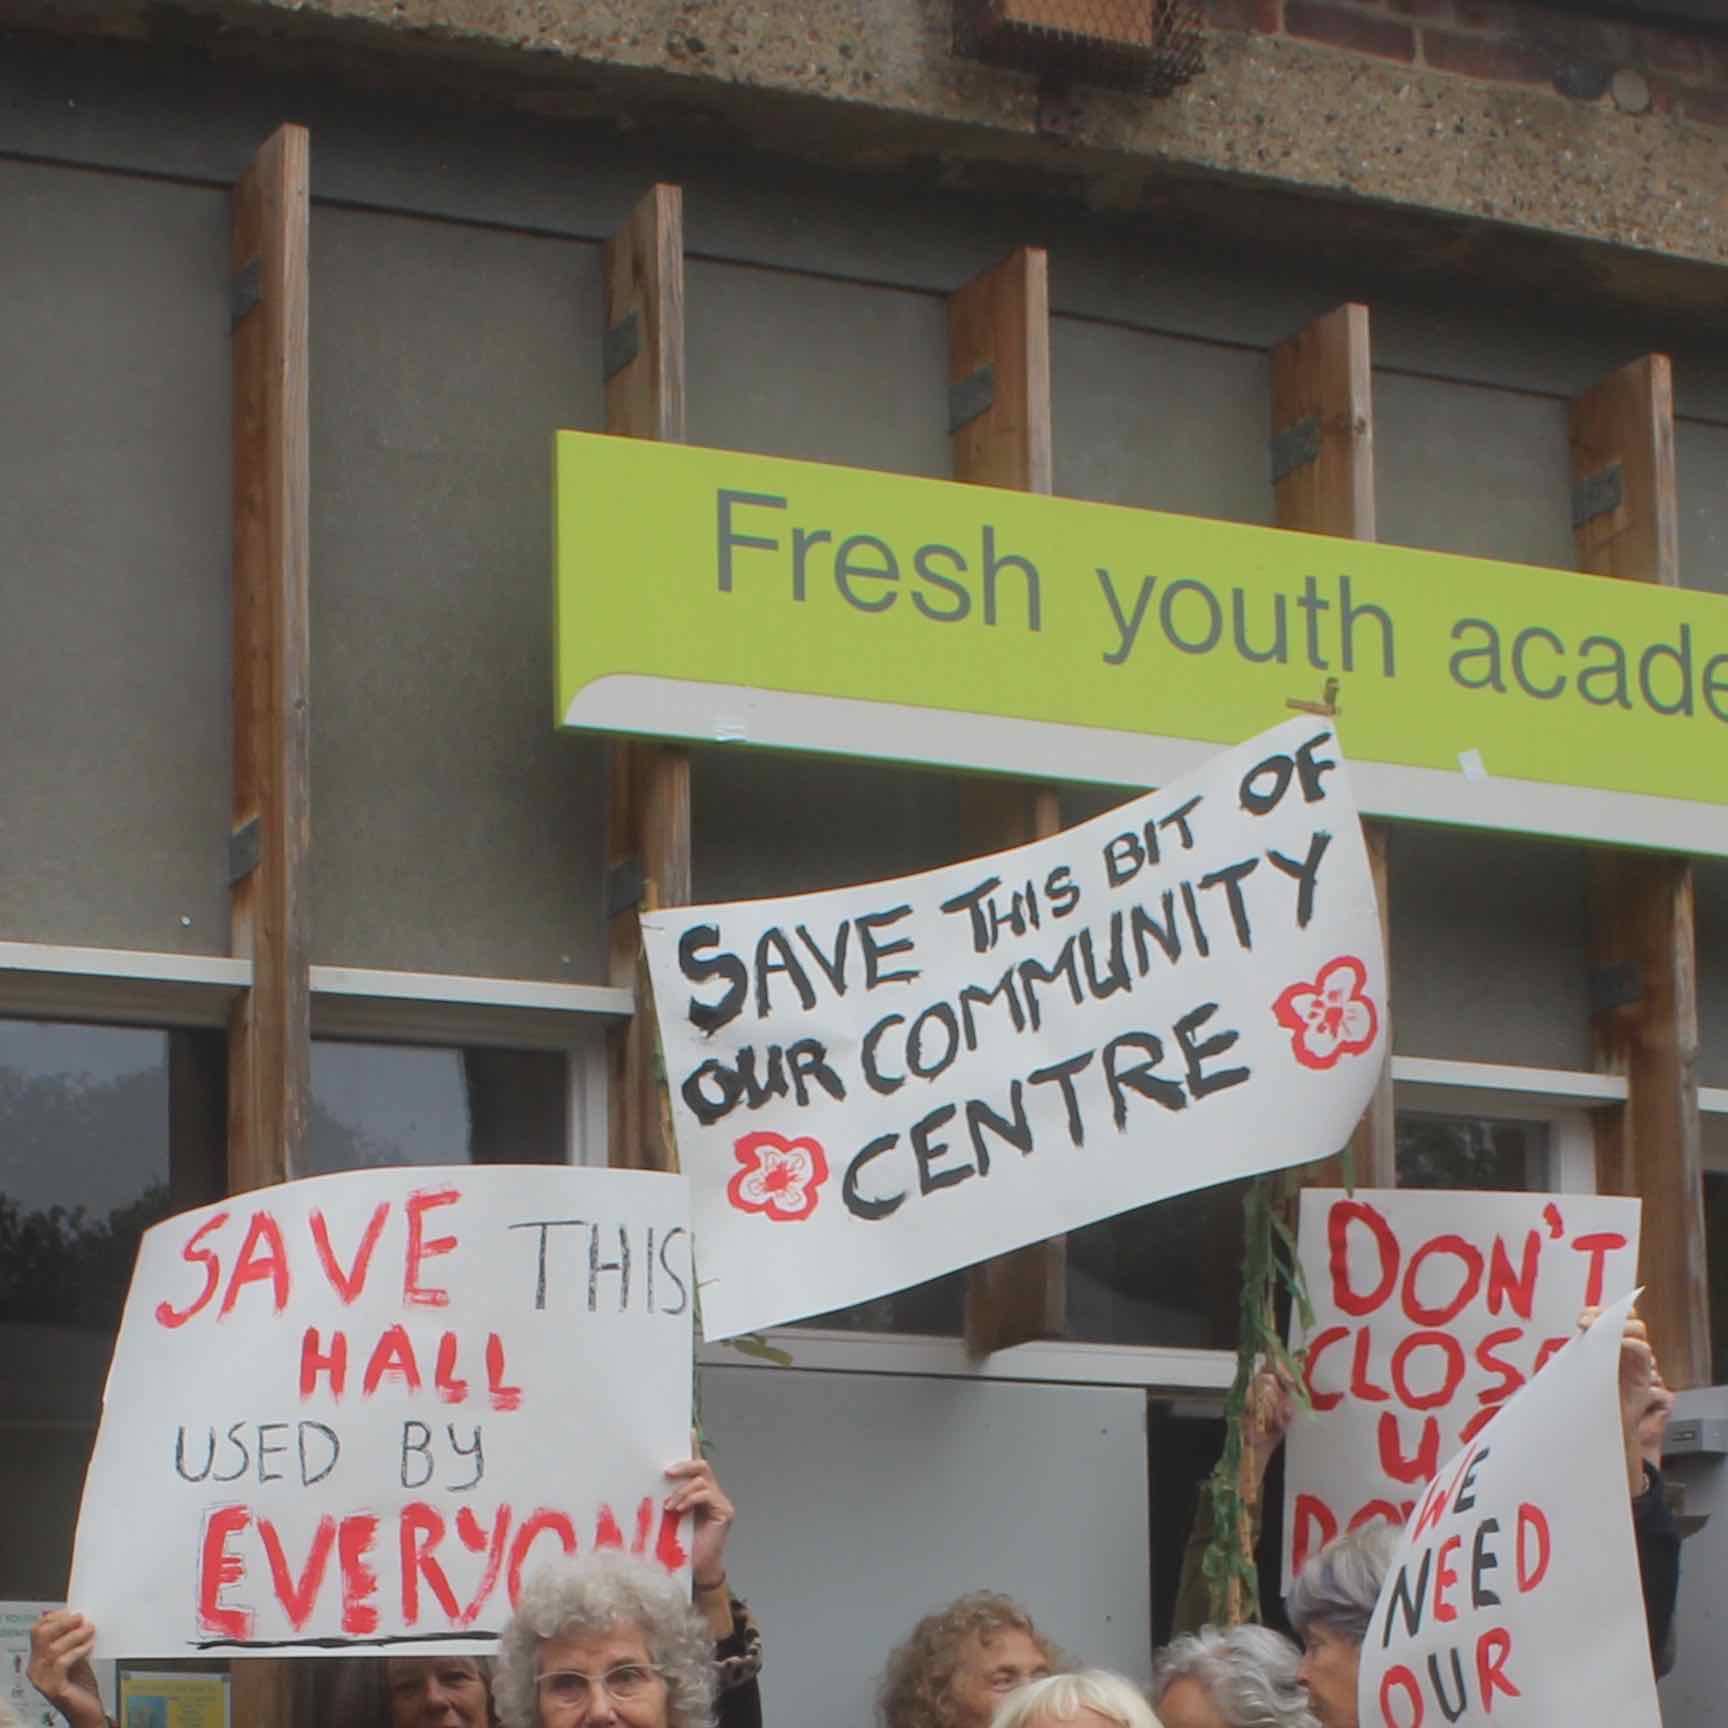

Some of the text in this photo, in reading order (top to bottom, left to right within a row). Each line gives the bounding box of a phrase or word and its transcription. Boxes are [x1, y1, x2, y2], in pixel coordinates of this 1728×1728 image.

[717, 488, 1042, 631] Fresh
[1094, 567, 1397, 678] youth
[677, 732, 1336, 1036] SAVE THIS BIT OF
[680, 830, 1333, 1126] OUR COMMUNITY
[841, 1002, 1250, 1221] CENTRE
[155, 1187, 687, 1328] SAVE THIS
[1327, 1201, 1626, 1326] DON'T
[299, 1323, 522, 1411] HALL
[174, 1420, 485, 1493] USED BY
[1412, 1442, 1490, 1543] WE
[1383, 1502, 1551, 1647] NEED
